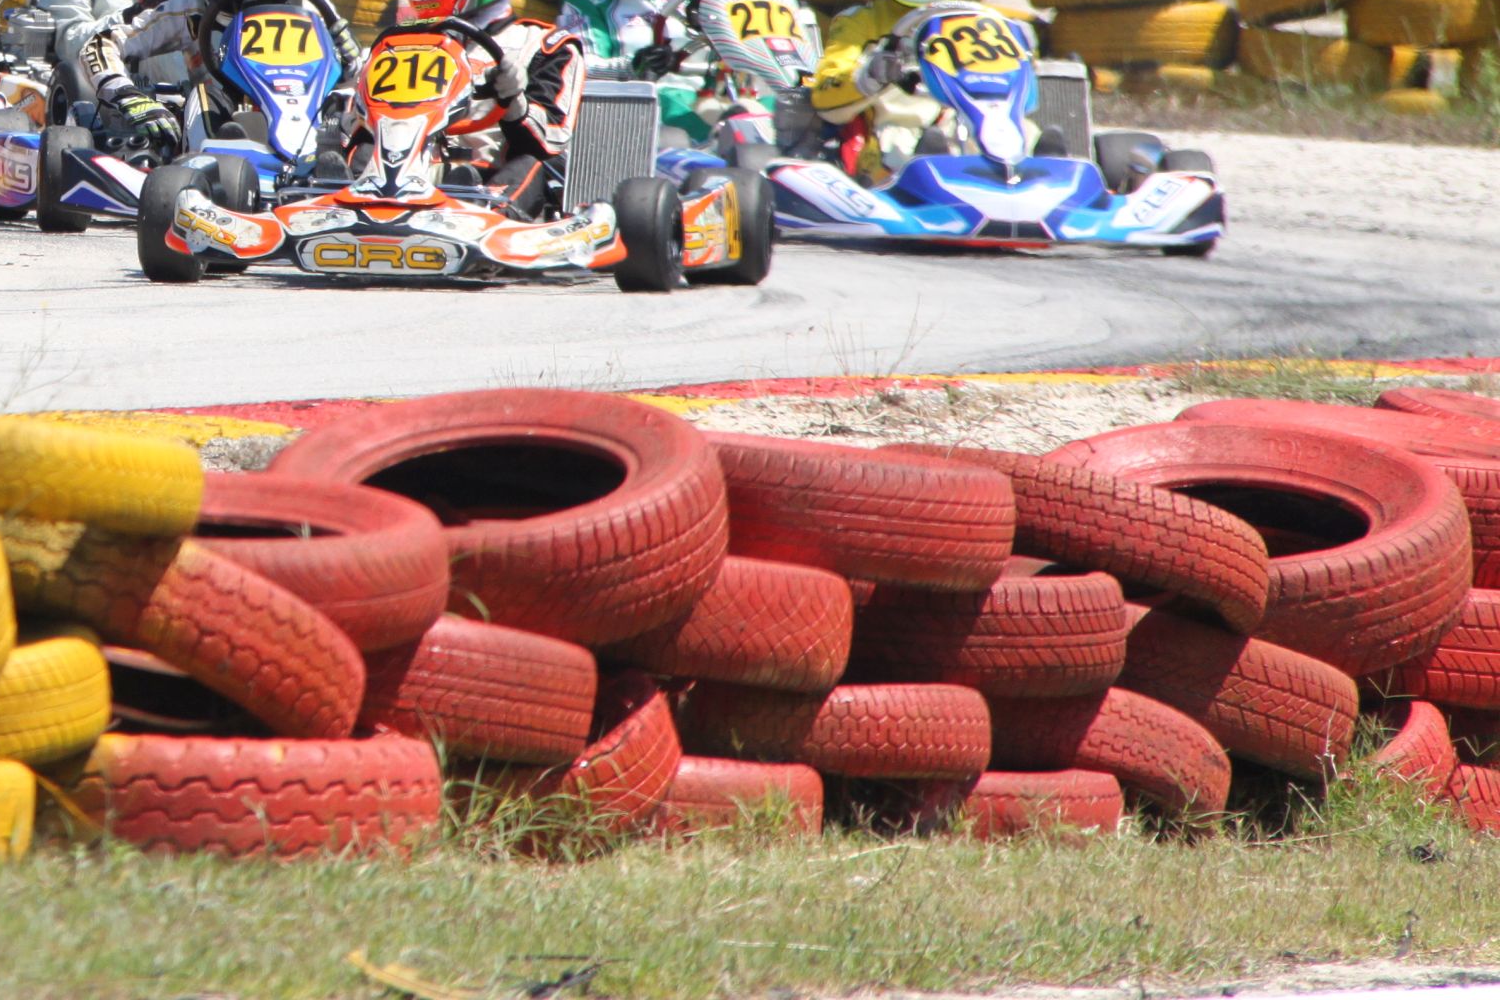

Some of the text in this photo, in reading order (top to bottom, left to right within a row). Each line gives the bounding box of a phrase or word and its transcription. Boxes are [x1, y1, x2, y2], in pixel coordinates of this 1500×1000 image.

[241, 18, 313, 56] 277
[730, 0, 803, 41] 272
[929, 17, 1020, 71] 233
[371, 53, 449, 97] 214
[176, 208, 237, 246] CRG
[313, 242, 447, 271] CRG
